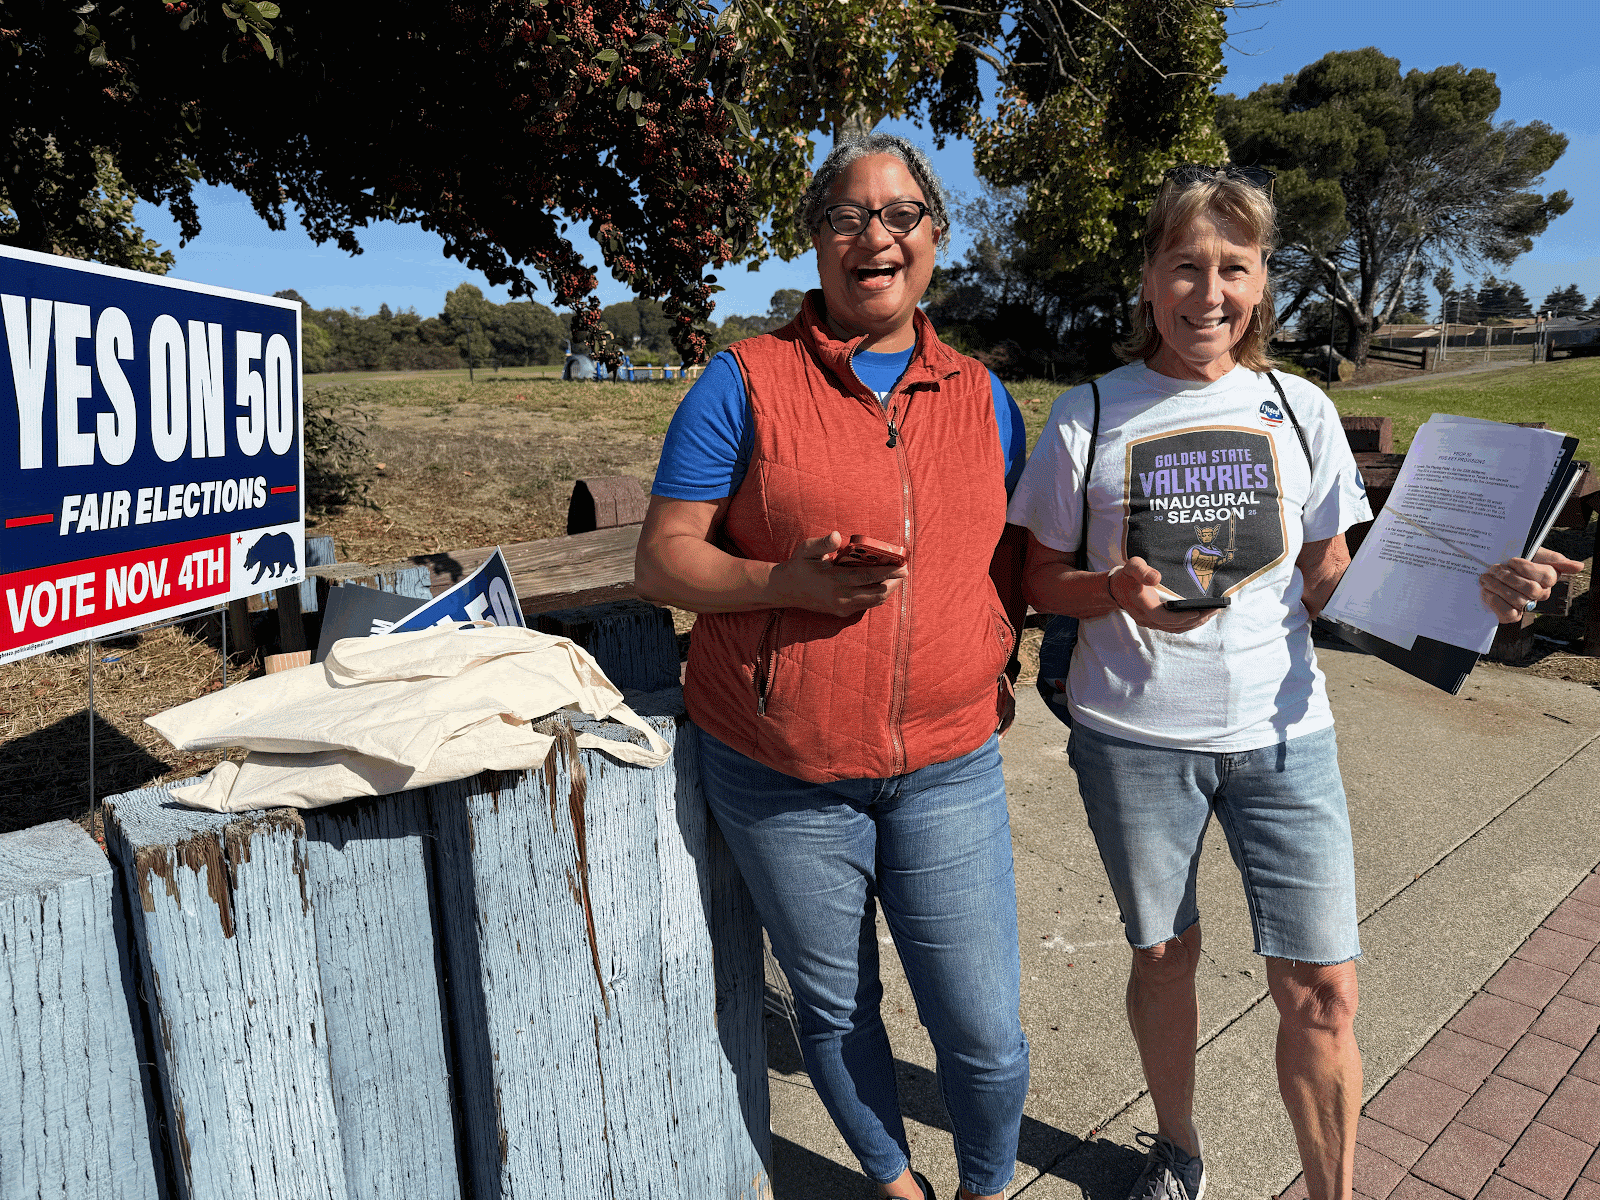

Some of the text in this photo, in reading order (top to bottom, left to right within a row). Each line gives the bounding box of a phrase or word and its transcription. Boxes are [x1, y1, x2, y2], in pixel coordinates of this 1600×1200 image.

[0, 293, 294, 470] YES ON 50
[1155, 448, 1252, 468] GOLDEN STATE
[1139, 463, 1268, 498] VALKYRIES
[59, 476, 267, 536] FAIR ELECTIONS
[1149, 491, 1260, 512] INAUGURAL
[1167, 506, 1245, 525] SEASON
[6, 546, 225, 634] VOTE NOV. 4TH
